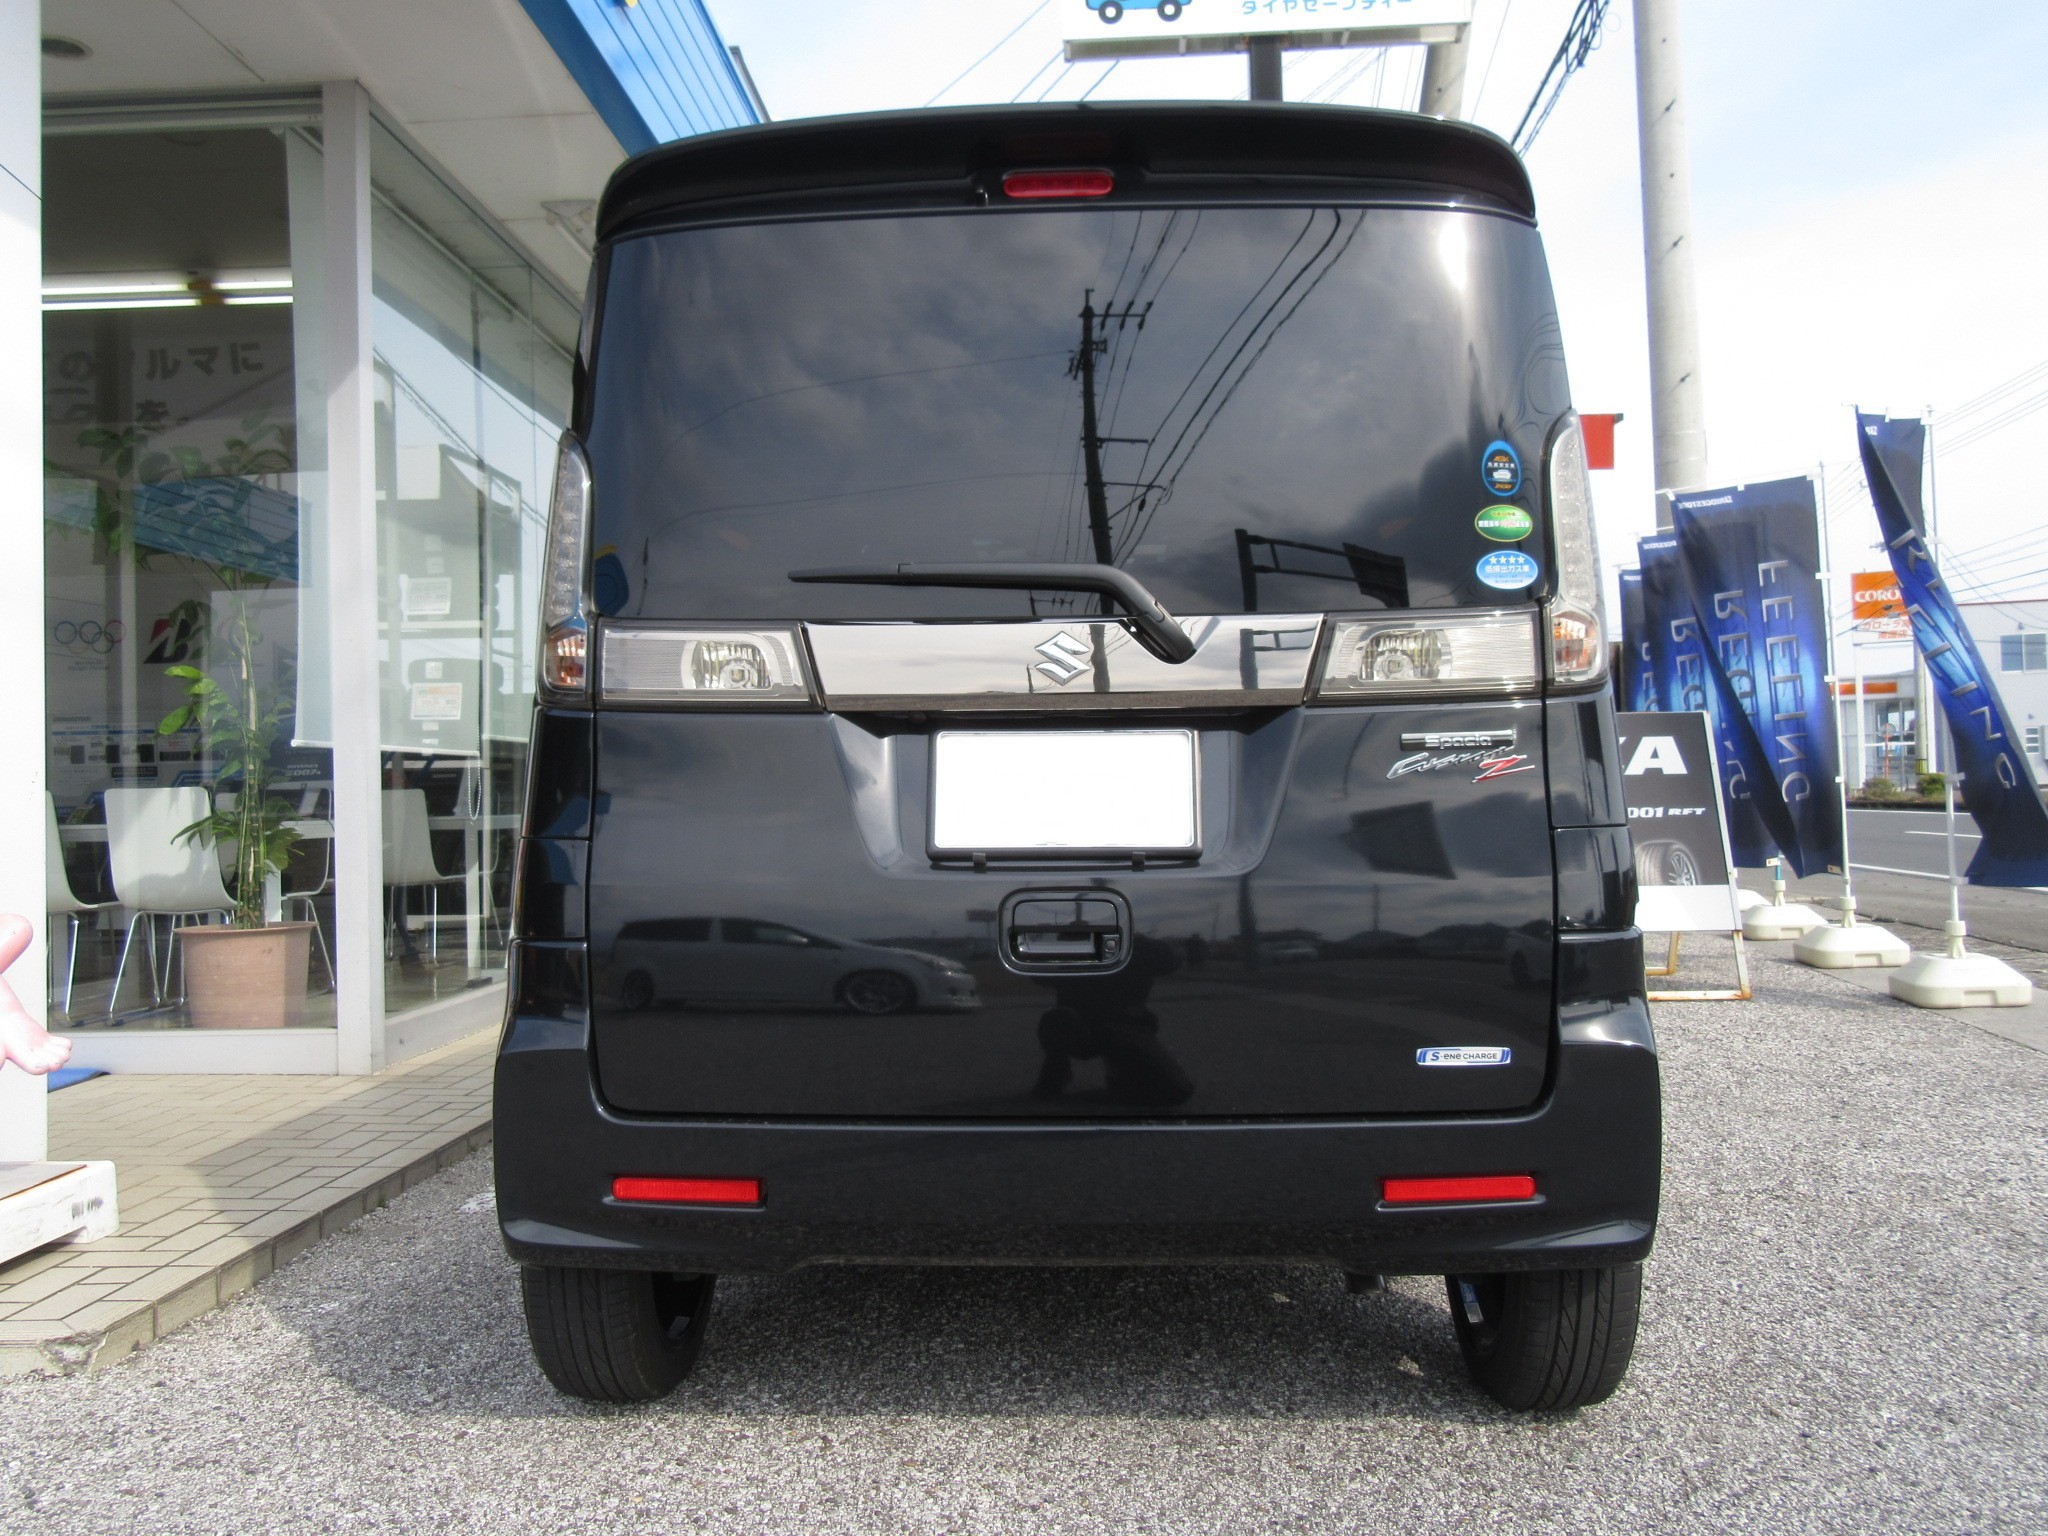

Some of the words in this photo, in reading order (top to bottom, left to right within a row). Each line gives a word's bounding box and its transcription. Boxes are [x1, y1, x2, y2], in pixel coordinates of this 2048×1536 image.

[1424, 733, 1492, 749] Spacia
[1618, 736, 1688, 775] A
[1472, 754, 1535, 784] Z
[1667, 807, 1706, 816] RFT
[1462, 1052, 1498, 1060] CHARGE
